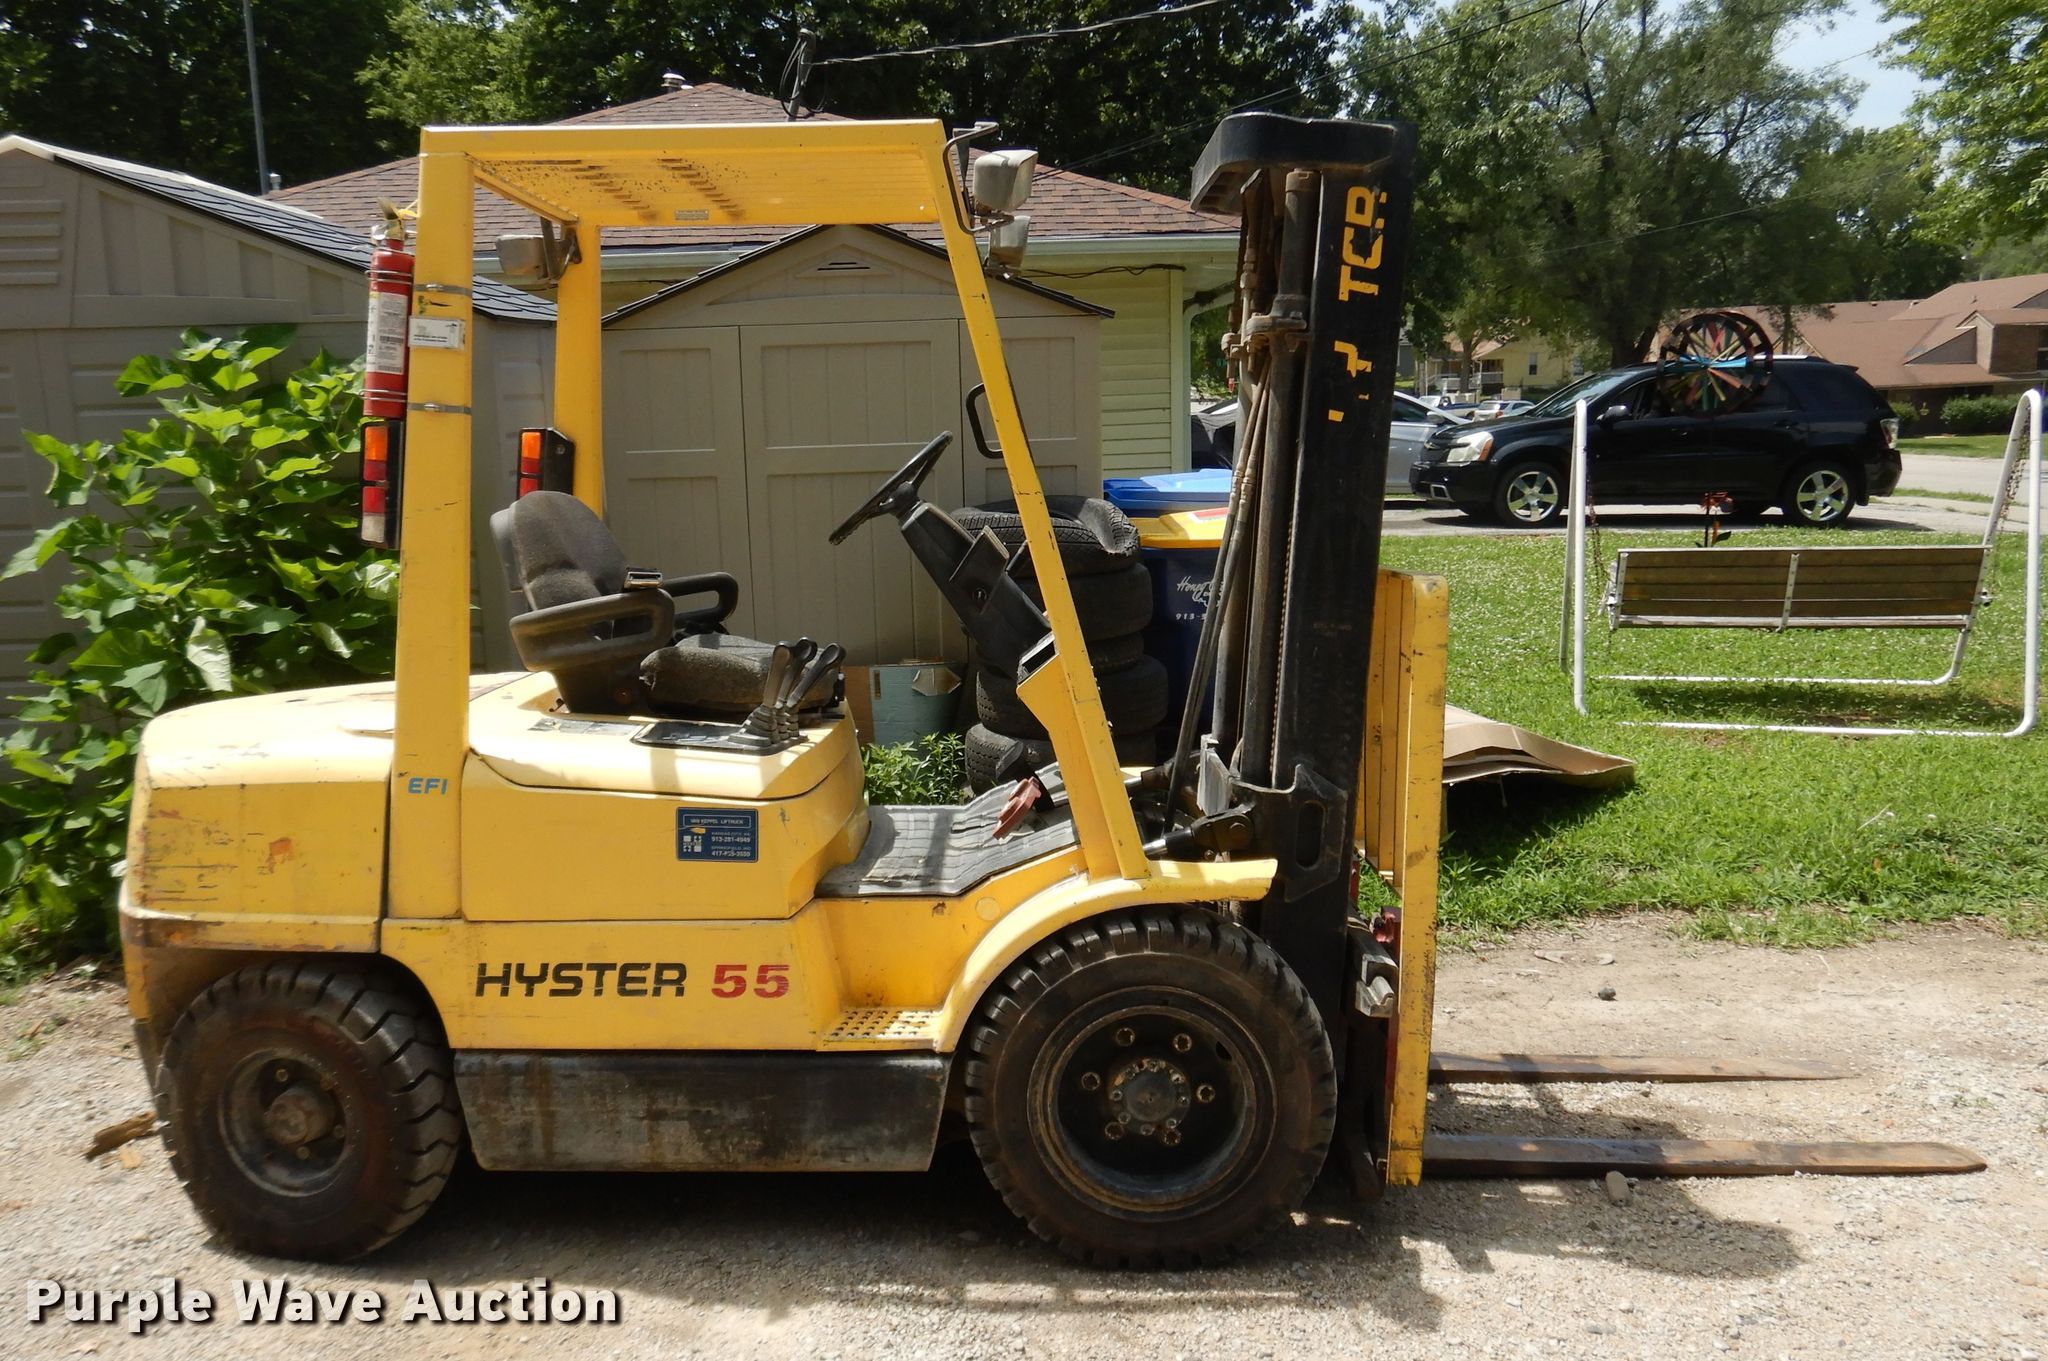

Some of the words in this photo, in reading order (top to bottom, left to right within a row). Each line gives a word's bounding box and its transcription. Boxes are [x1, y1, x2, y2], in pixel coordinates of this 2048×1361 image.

[408, 777, 449, 795] EFI
[474, 962, 687, 998] HYSTER
[710, 964, 790, 999] 55
